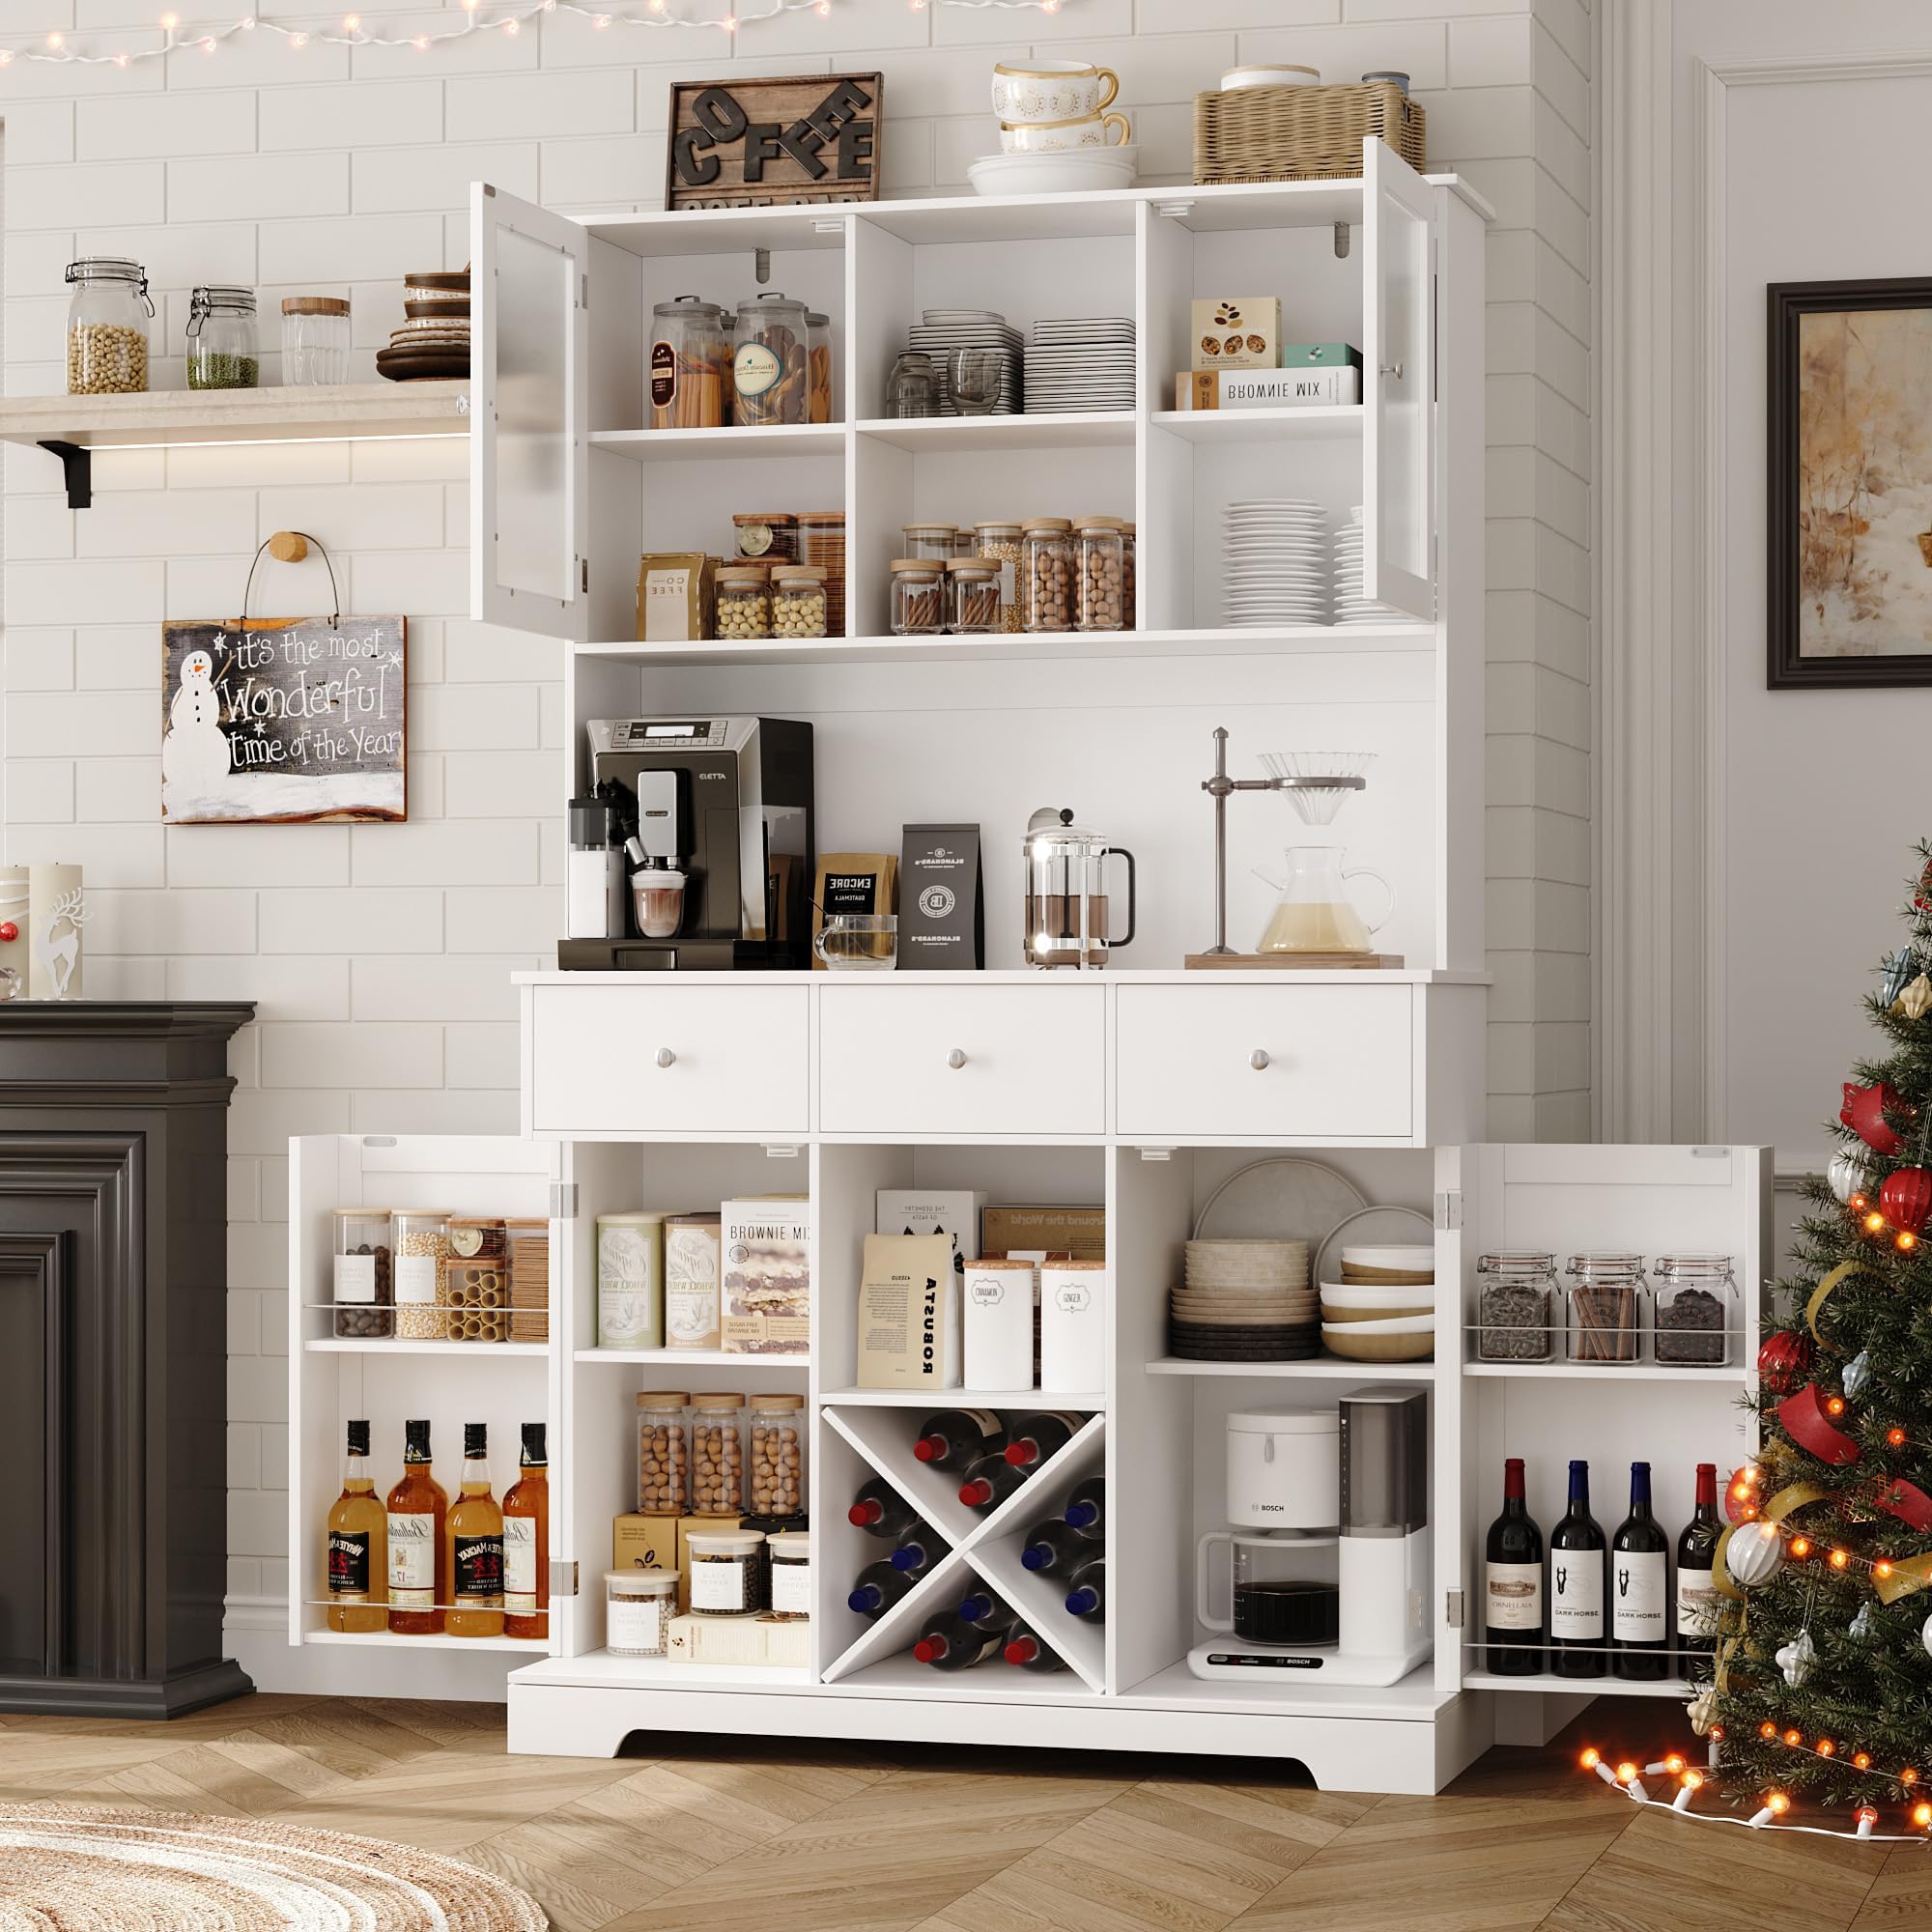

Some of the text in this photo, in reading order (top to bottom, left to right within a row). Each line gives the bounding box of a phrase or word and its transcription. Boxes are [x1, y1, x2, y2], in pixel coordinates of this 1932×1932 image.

[675, 79, 873, 185] COFFEE
[237, 629, 387, 669] it's the most
[219, 665, 388, 724] Wonderful
[229, 725, 402, 767] time of the Year
[730, 1226, 786, 1239] BROWNIE
[976, 1288, 998, 1296] CINNAMON
[1063, 1293, 1082, 1303] GINGER
